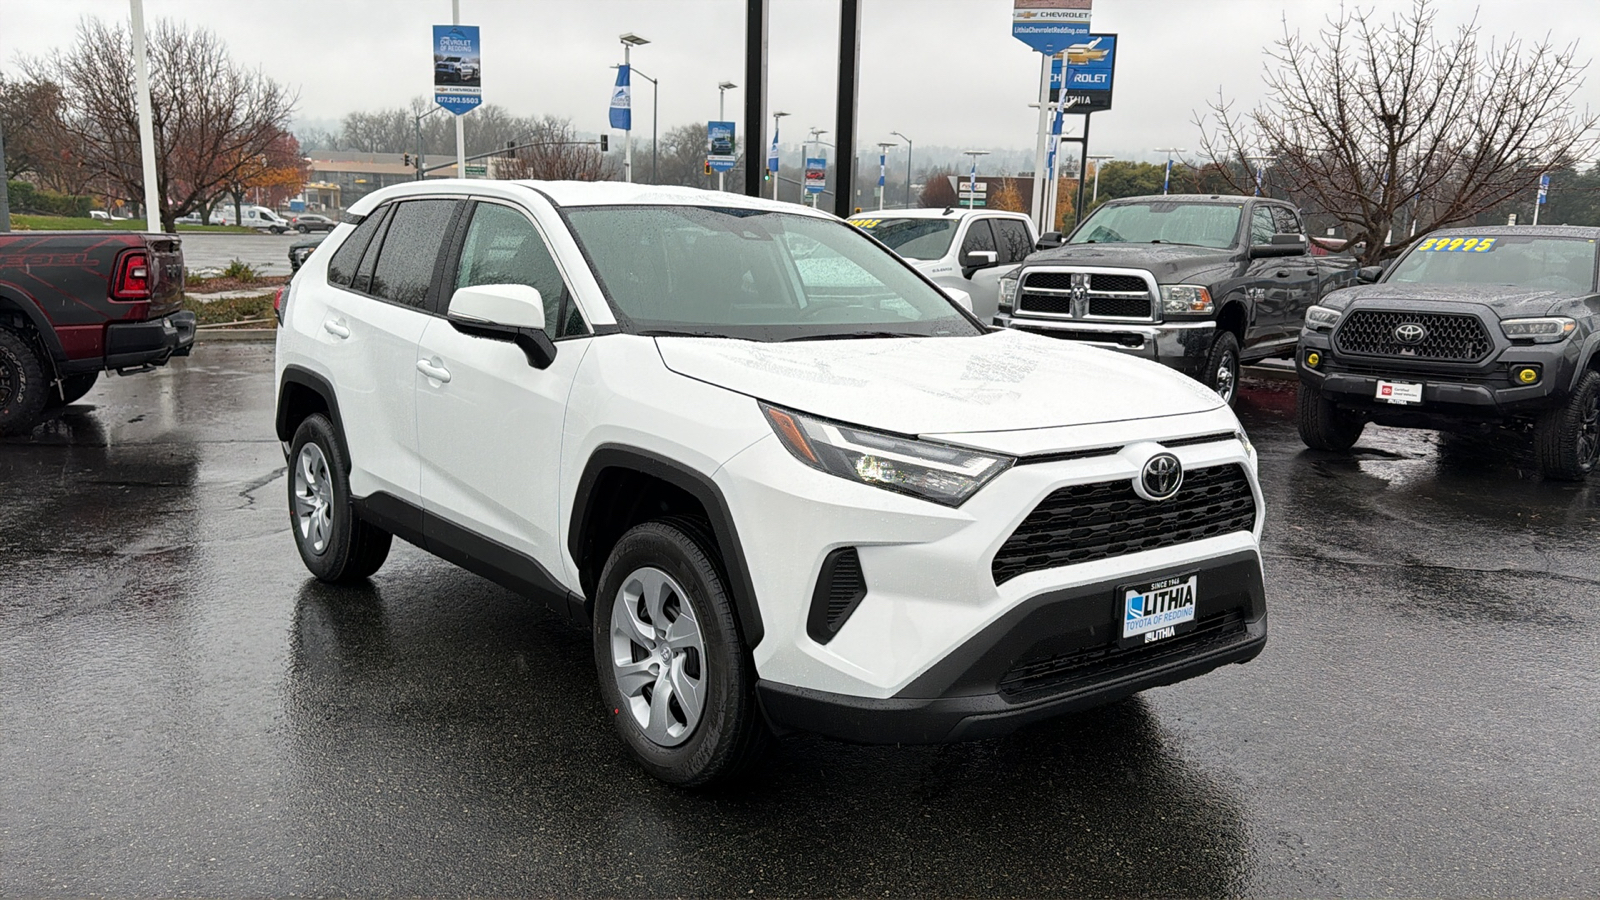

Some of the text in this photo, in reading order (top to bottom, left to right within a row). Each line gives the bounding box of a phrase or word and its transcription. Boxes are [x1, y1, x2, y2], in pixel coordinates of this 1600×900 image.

[1014, 26, 1088, 35] LithiaChevroletRedding.com
[1050, 73, 1107, 83] CHROLET
[437, 96, 479, 104] 877.293.5503
[1064, 95, 1091, 104] ITHIA
[1418, 238, 1496, 252] 39995
[1151, 581, 1168, 590] SINCE
[1143, 585, 1193, 617] LITHIA
[1126, 607, 1193, 631] TOYOTA OF REDDING
[1151, 626, 1176, 640] LITHIA
